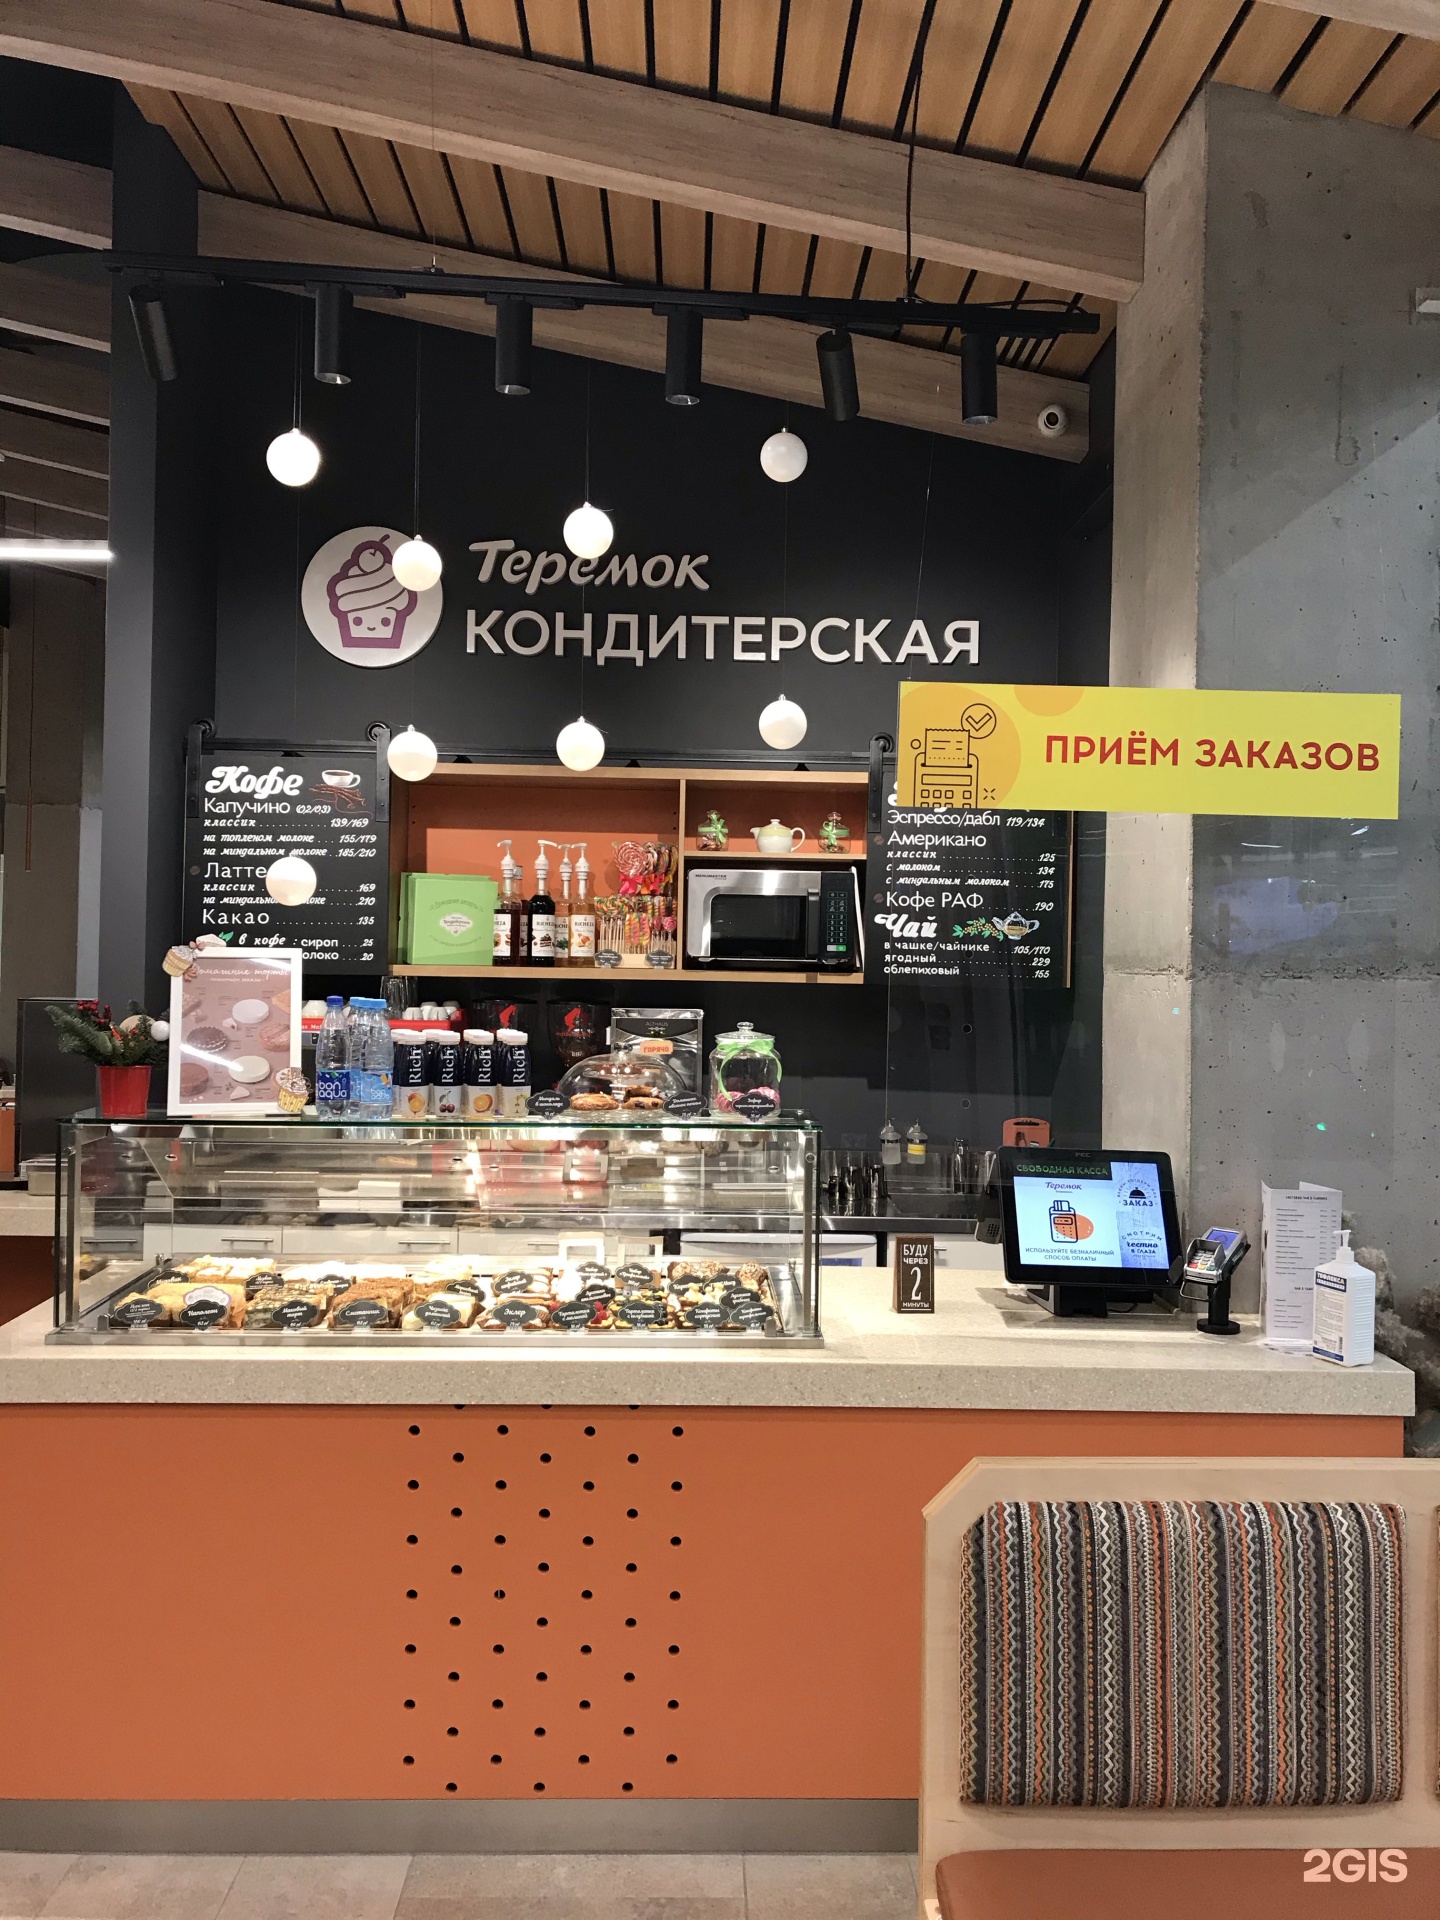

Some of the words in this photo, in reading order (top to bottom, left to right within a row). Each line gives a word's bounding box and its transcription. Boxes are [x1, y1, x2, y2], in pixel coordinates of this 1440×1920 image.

[469, 539, 709, 594] Теремок
[465, 609, 980, 667] КОНДИТЕРСКАЯ
[1046, 730, 1179, 767] ПРИЁМ
[1194, 739, 1380, 772] ЗАКАЗОВ
[205, 766, 303, 799] Кофе
[204, 798, 290, 818] Капучино
[203, 819, 257, 827] классик
[330, 818, 369, 828] 139/169
[887, 810, 1000, 828] Эспрессо/дабл
[1006, 817, 1045, 827] 119/134
[220, 834, 273, 842] топленом
[277, 835, 315, 843] молоке
[339, 834, 377, 844] 155/179
[887, 830, 987, 849] Американо
[203, 848, 216, 856] на
[220, 848, 285, 857] миндальном
[289, 849, 328, 857] молоке
[338, 848, 377, 857] 185/210
[886, 851, 937, 859] классик
[1039, 853, 1056, 862] 125
[204, 862, 268, 878] Латте
[896, 863, 941, 871] молоком
[1038, 867, 1056, 875] 134
[203, 883, 256, 892] классик
[359, 883, 376, 892] 169
[896, 876, 961, 887] миндальным
[965, 878, 1010, 887] молоком
[1038, 880, 1054, 889] 175
[220, 897, 279, 906] миндально
[357, 897, 376, 906] 210
[886, 891, 935, 911] Кофе
[941, 891, 984, 908] РАФ
[1034, 902, 1054, 911] 190
[202, 909, 270, 924] Какао
[358, 916, 374, 925] 135
[874, 913, 938, 938] Чай
[239, 933, 248, 945] в
[254, 933, 286, 947] кофе
[301, 938, 339, 949] сироп
[362, 938, 374, 947] 25
[884, 942, 891, 950] в
[895, 941, 990, 952] чашке/чайнике
[1013, 946, 1051, 955] 105/170
[302, 951, 339, 960] олоко
[362, 953, 374, 961] 20
[884, 953, 937, 964] ягодный
[1031, 957, 1051, 966] 229
[884, 964, 960, 976] облепиховый
[1034, 970, 1050, 979] 155
[1016, 1164, 1075, 1174] СВОБОДНАЯ
[1077, 1166, 1109, 1176] КАССА
[1045, 1181, 1083, 1191] Теремок
[903, 1244, 928, 1257] БУДУ
[910, 1266, 922, 1300] 2
[504, 1309, 526, 1317] Эклер
